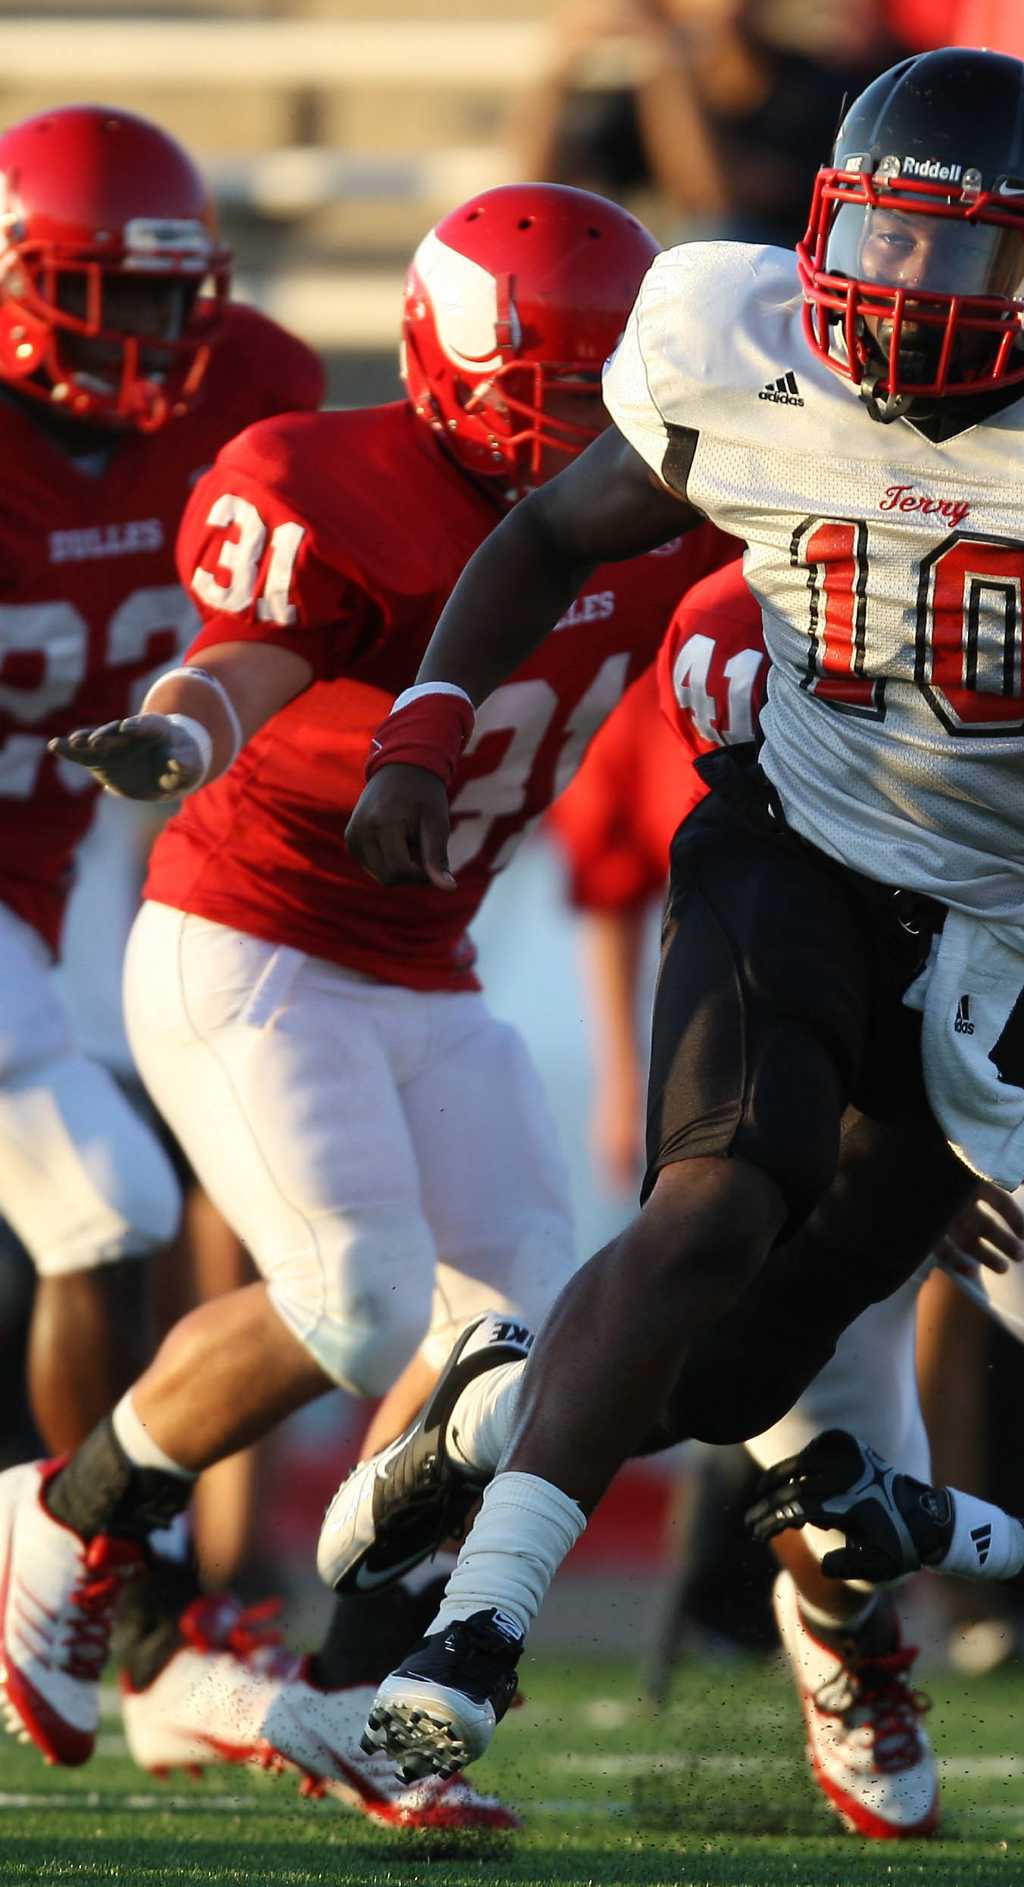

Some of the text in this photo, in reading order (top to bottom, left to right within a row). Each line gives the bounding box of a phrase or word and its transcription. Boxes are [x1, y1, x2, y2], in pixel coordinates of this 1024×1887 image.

[903, 156, 962, 182] Riddell
[758, 390, 805, 408] adidas
[879, 485, 970, 528] Terry
[50, 517, 163, 564] DULLES
[191, 493, 305, 627] 31
[673, 633, 763, 746] 41
